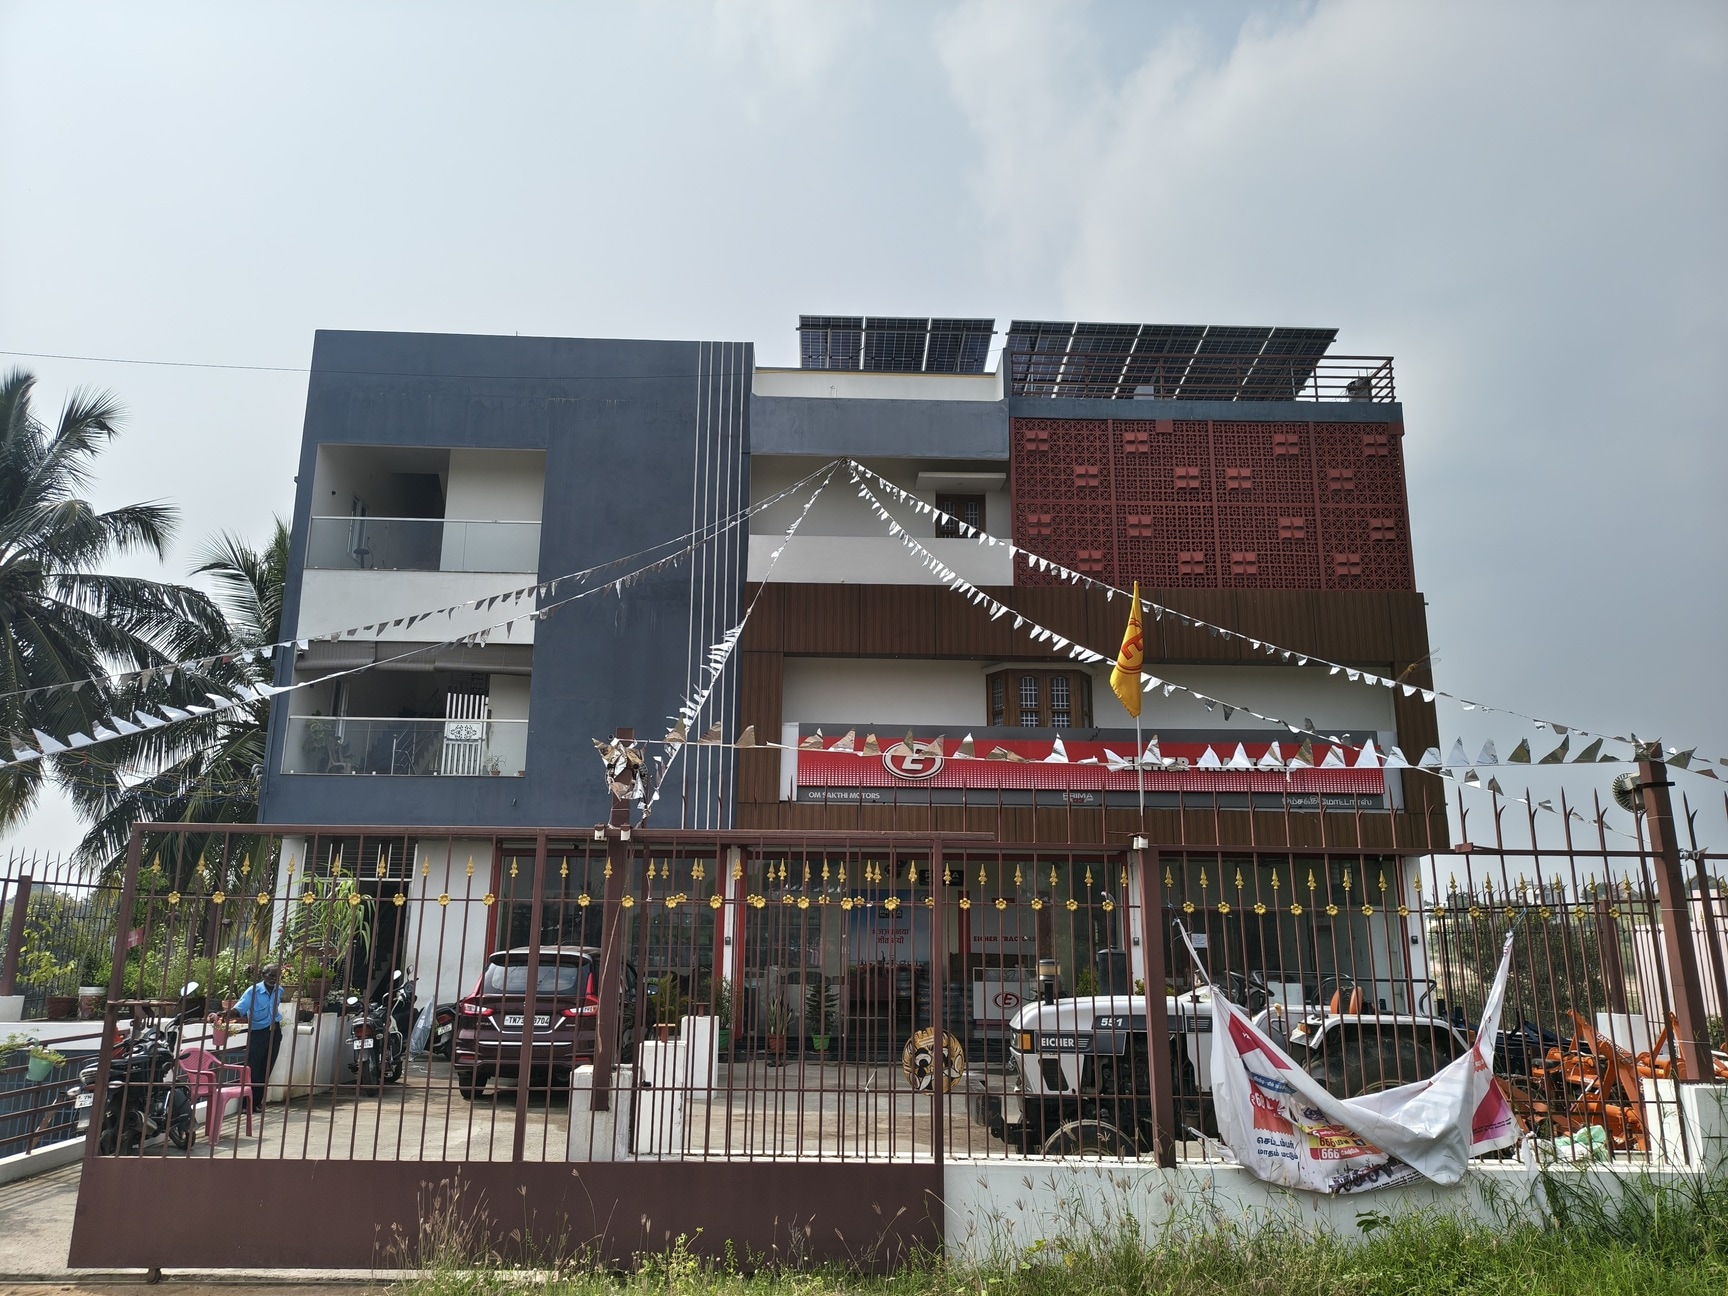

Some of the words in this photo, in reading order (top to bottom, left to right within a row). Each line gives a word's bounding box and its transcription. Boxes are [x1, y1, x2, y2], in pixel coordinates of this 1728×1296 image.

[1100, 1017, 1123, 1027] 551
[1041, 1037, 1075, 1047] EICHER
[1321, 1148, 1340, 1159] 666
